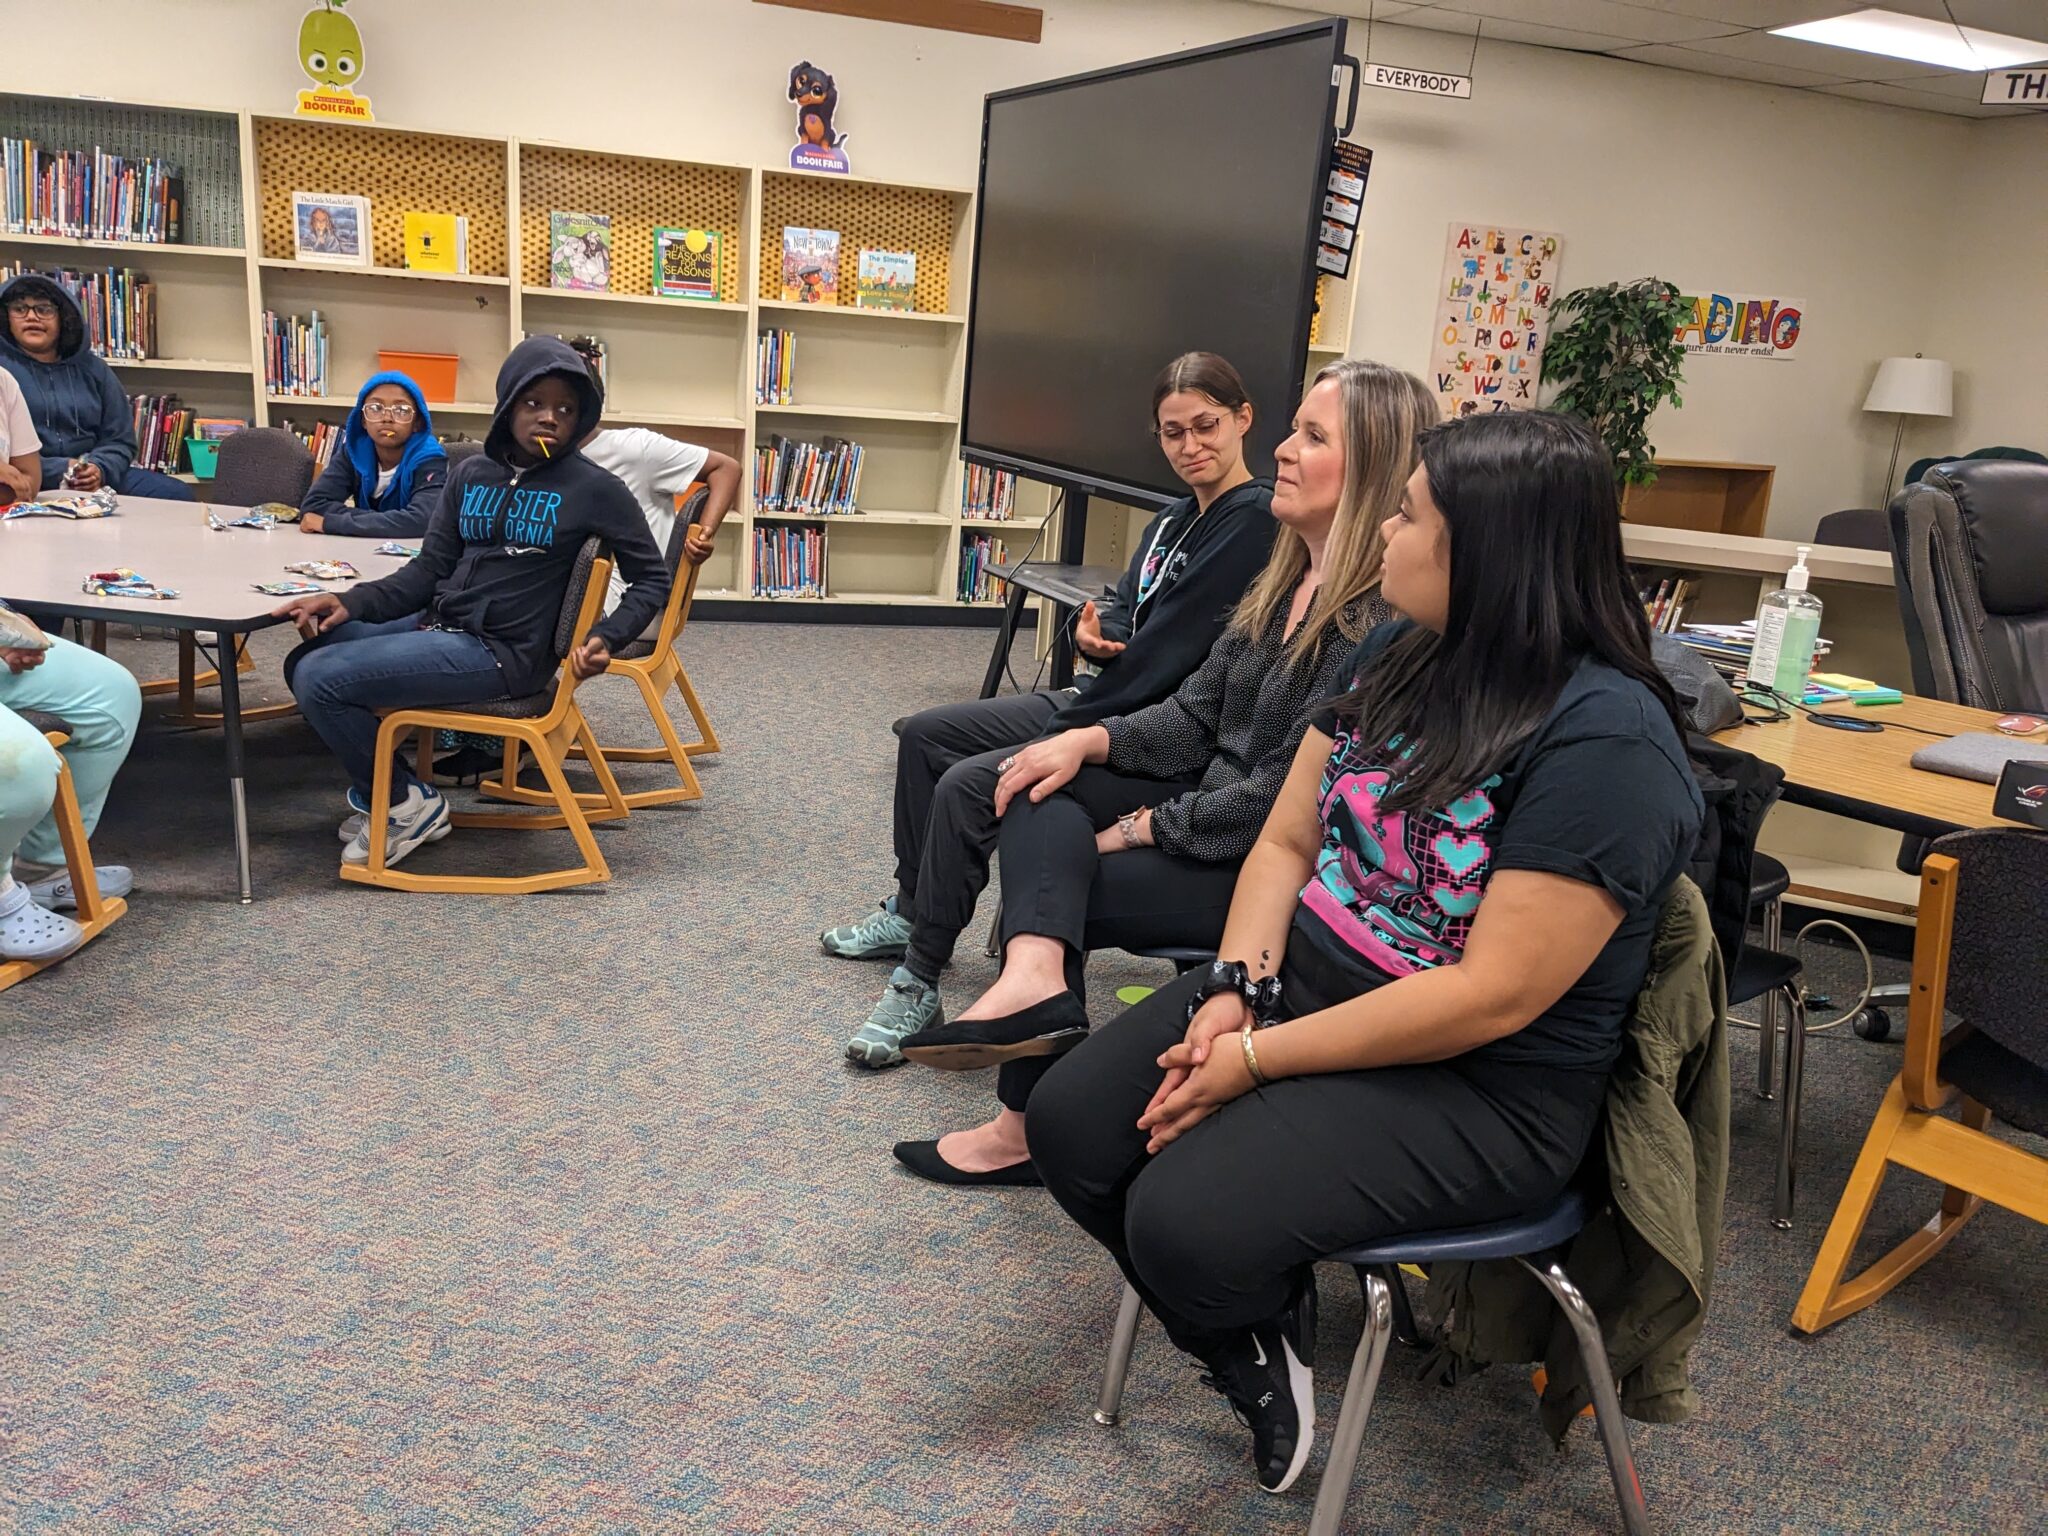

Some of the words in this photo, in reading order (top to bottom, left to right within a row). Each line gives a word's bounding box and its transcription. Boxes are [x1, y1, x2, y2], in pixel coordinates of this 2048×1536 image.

[1376, 68, 1460, 93] EVERYBODY
[2005, 73, 2048, 99] TH
[304, 101, 337, 113] BOOK
[338, 104, 365, 115] FAIR
[796, 155, 822, 167] BOOK
[822, 158, 843, 170] FAIR
[672, 244, 686, 252] THE
[1457, 229, 1470, 249] A
[1485, 232, 1496, 251] B
[1521, 235, 1533, 255] C
[1545, 237, 1556, 255] D
[664, 250, 711, 263] REASONS
[680, 260, 696, 268] FOR
[1477, 255, 1486, 275] E
[1503, 258, 1513, 273] F
[1530, 261, 1541, 280] G
[664, 265, 711, 278] SEASONS
[1450, 277, 1463, 297] H
[1489, 304, 1505, 324] M
[1517, 307, 1531, 326] N
[1660, 294, 1801, 349] ADING
[1443, 325, 1457, 346] O
[1474, 328, 1487, 348] P
[1500, 330, 1513, 350] Q
[1706, 344, 1722, 353] that
[1725, 345, 1749, 355] never
[1751, 346, 1774, 356] ends!
[1455, 351, 1467, 371] S
[1485, 354, 1495, 373] T
[1509, 355, 1520, 374] U
[1437, 373, 1451, 392] V
[1474, 376, 1493, 395] W
[1516, 379, 1531, 398] X
[460, 483, 562, 526] HOLLISTER
[459, 518, 553, 547] CALIFORNIA
